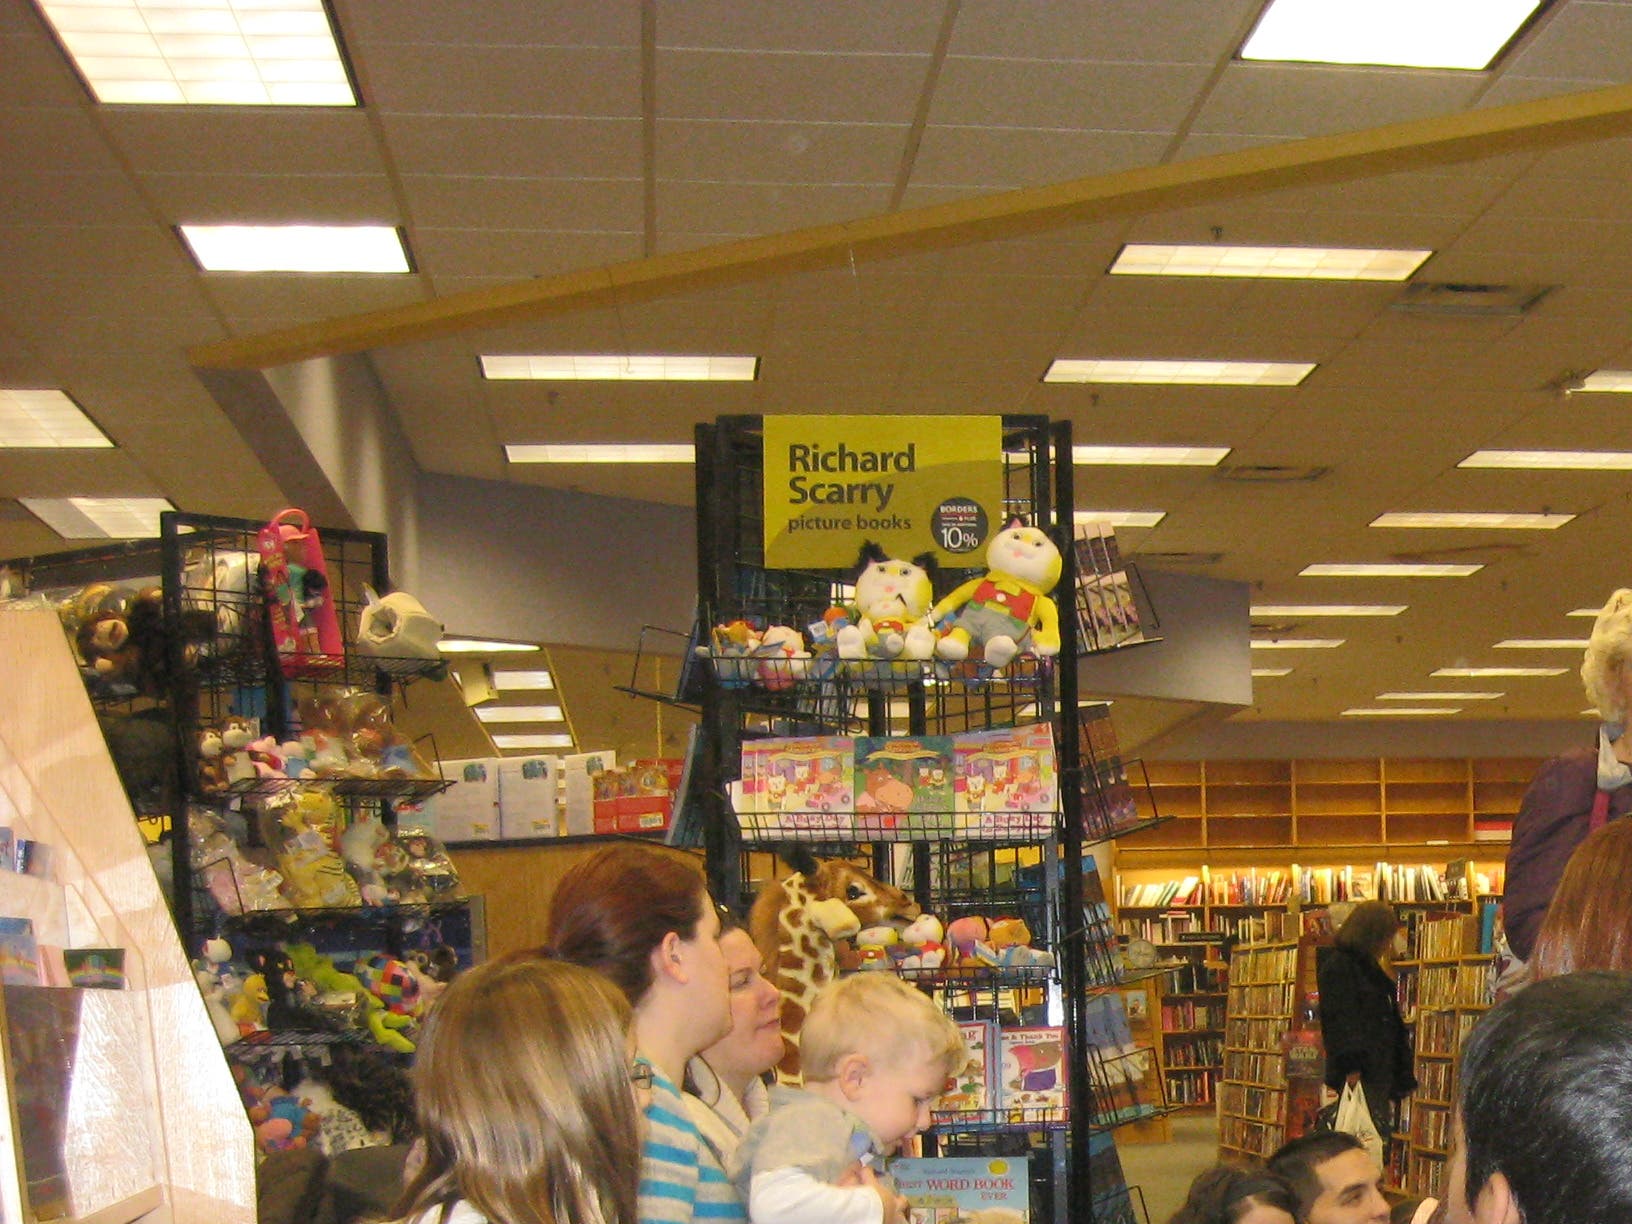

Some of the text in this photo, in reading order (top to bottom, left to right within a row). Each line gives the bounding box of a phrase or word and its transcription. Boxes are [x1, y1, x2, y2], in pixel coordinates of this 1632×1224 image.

[789, 443, 916, 473] Richard
[789, 476, 894, 511] Scarry
[940, 505, 978, 513] BORDERS
[788, 513, 912, 533] picture books
[941, 527, 978, 548] 10%
[927, 1178, 969, 1190] WORD
[974, 1178, 1015, 1190] BOOK
[981, 1192, 1007, 1200] EVER
